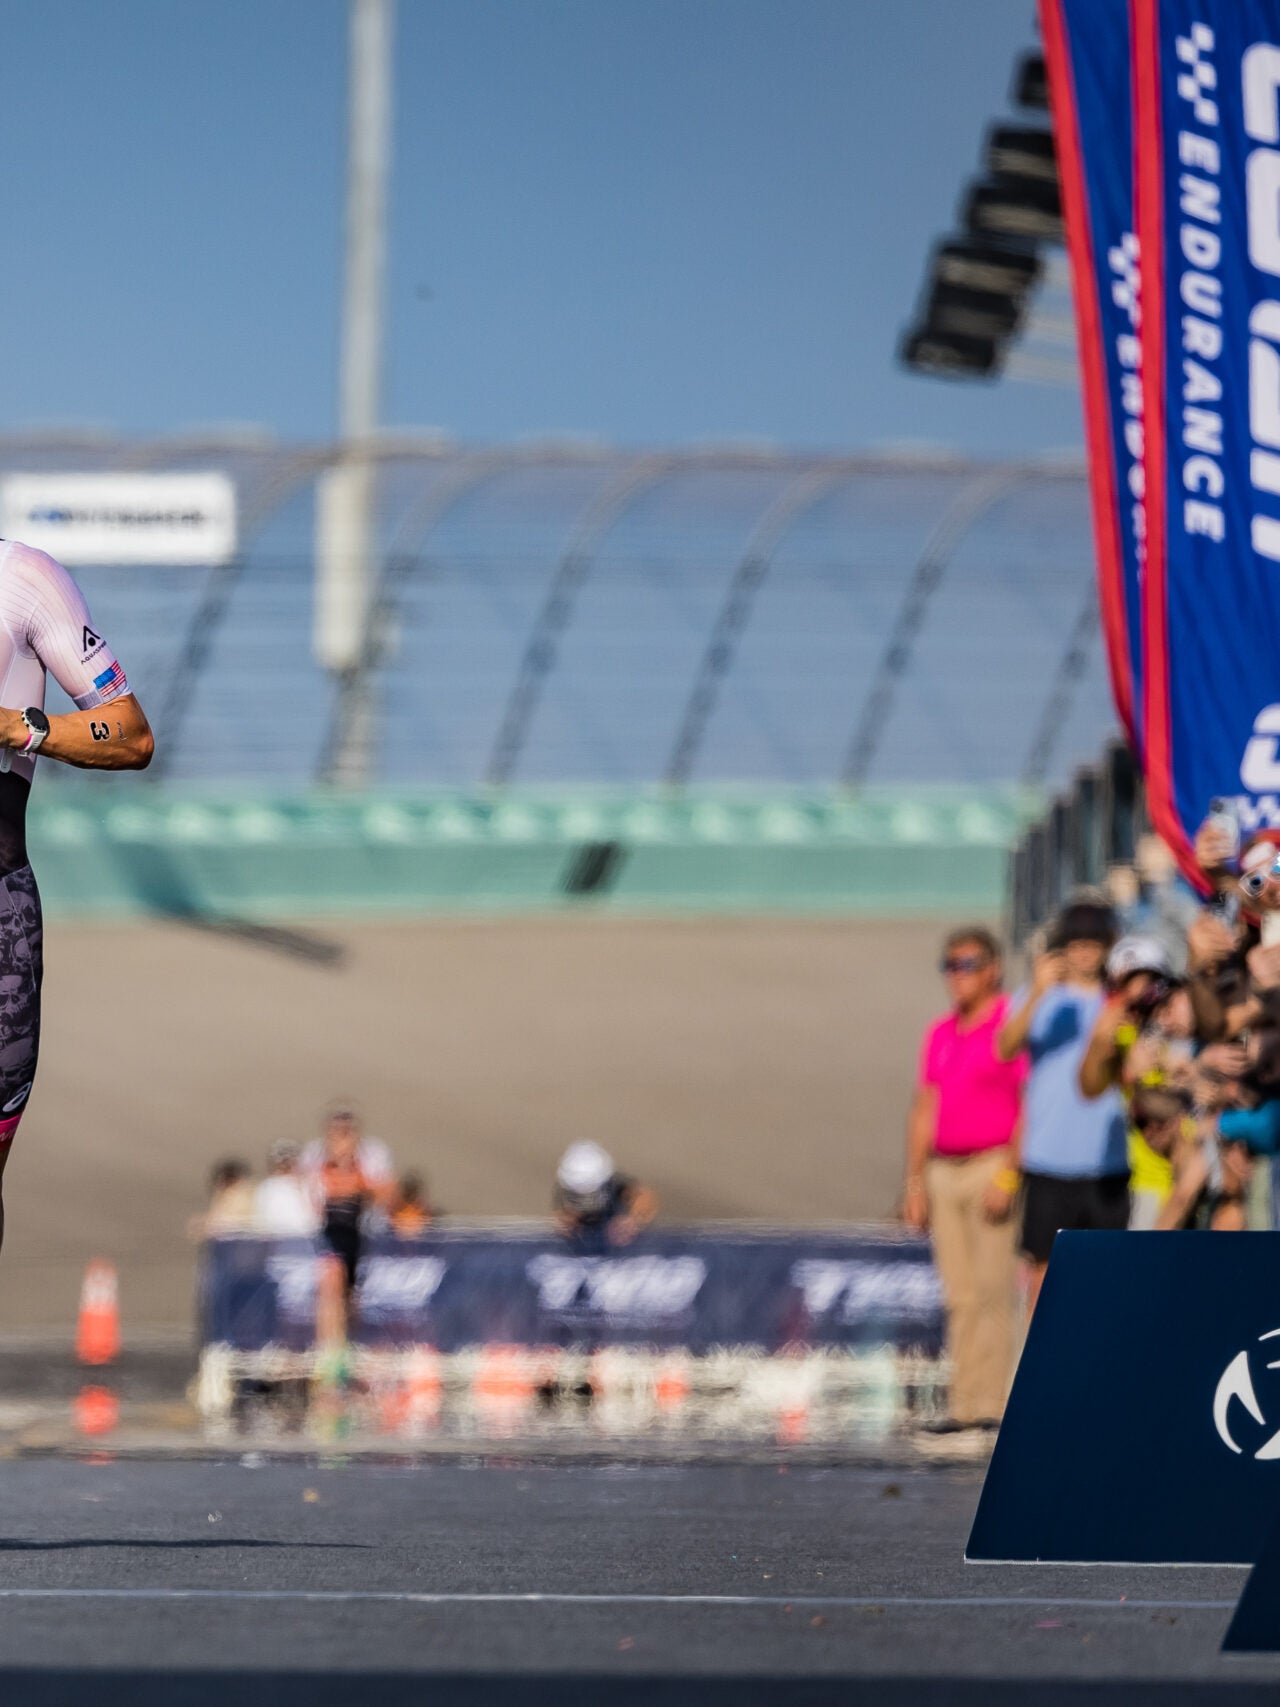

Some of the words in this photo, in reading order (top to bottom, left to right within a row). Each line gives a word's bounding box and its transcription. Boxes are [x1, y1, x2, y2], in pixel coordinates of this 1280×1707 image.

[1178, 130, 1226, 541] ENDURANCE
[81, 640, 108, 665] AQUASP
[90, 721, 111, 741] 3
